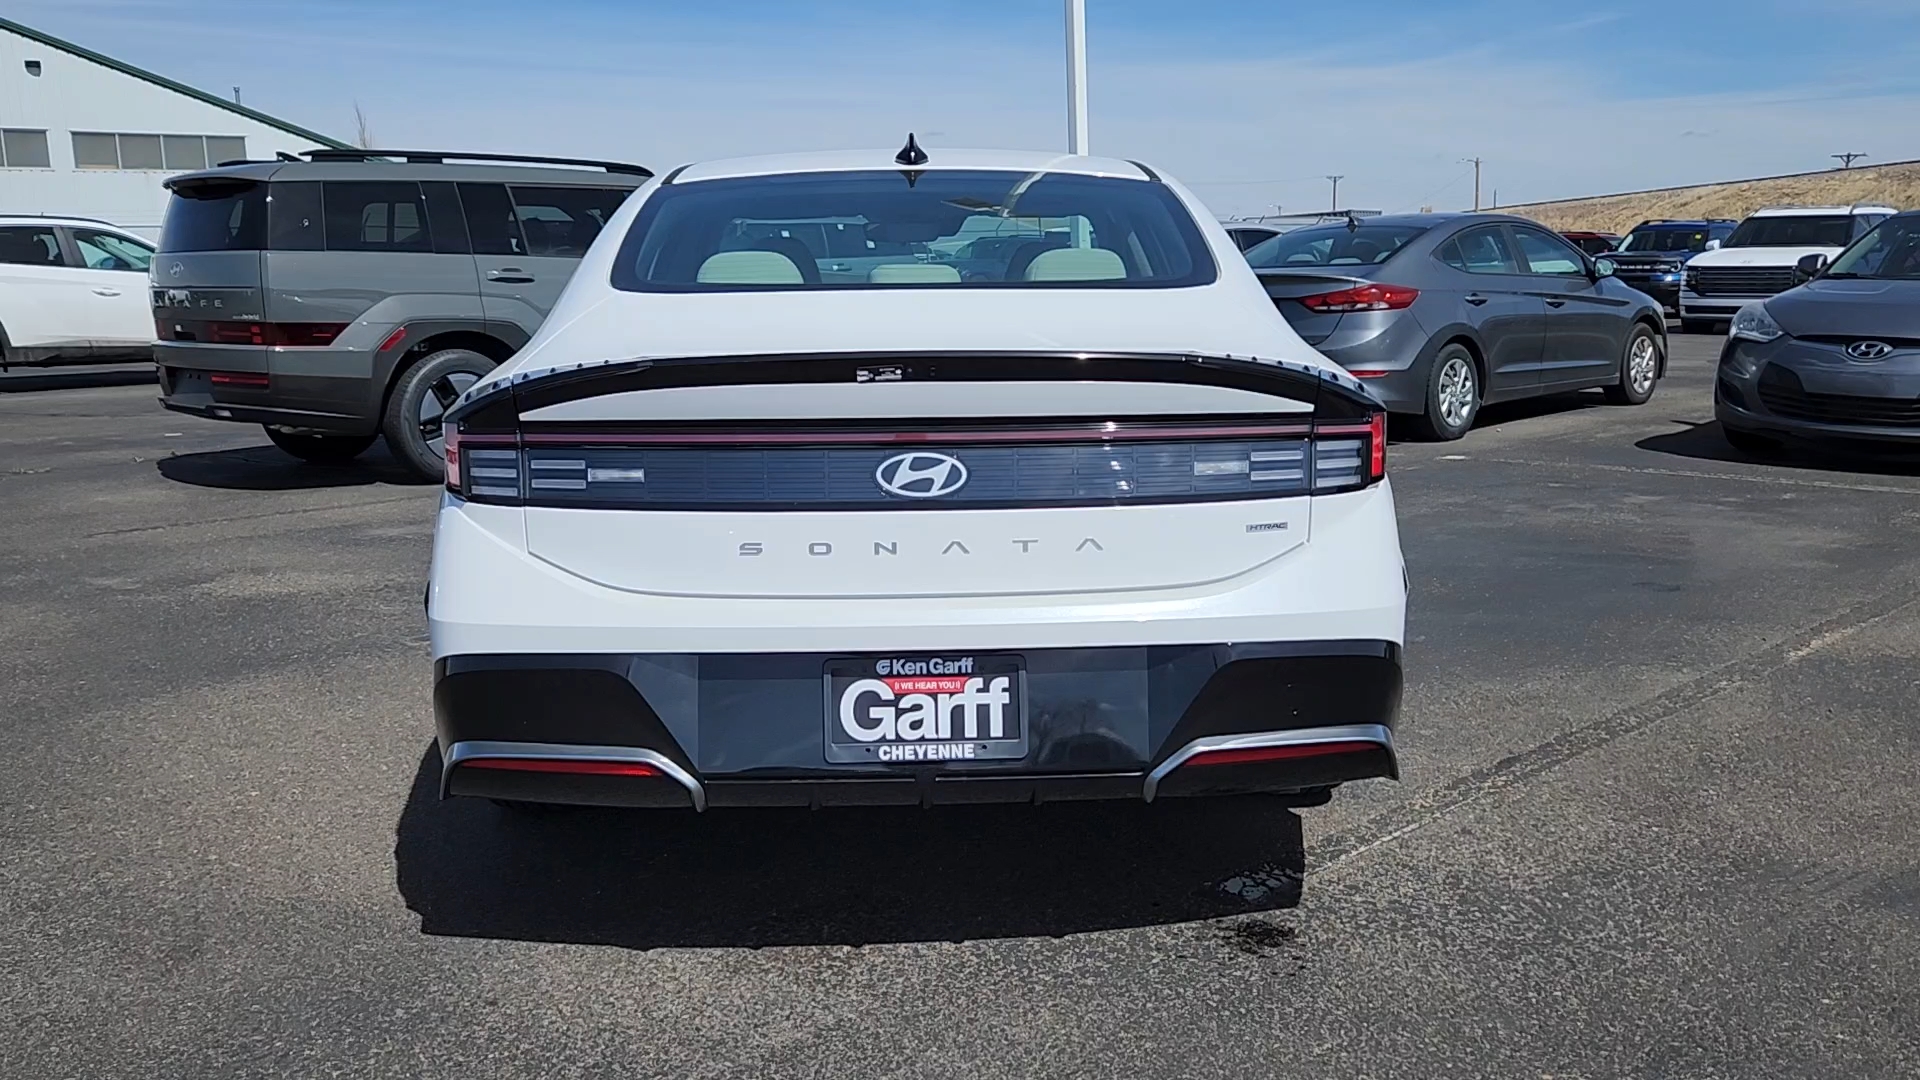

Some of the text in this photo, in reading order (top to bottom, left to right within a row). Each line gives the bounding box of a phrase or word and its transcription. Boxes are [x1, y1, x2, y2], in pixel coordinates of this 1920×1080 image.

[200, 299, 223, 308] FE
[1248, 522, 1288, 532] HTRAC
[738, 537, 1104, 557] SONATA
[892, 657, 974, 675] Ken Garff
[900, 680, 955, 690] WE HEAR YOU
[840, 677, 1010, 742] Garff
[878, 744, 975, 760] CHEYENNE
